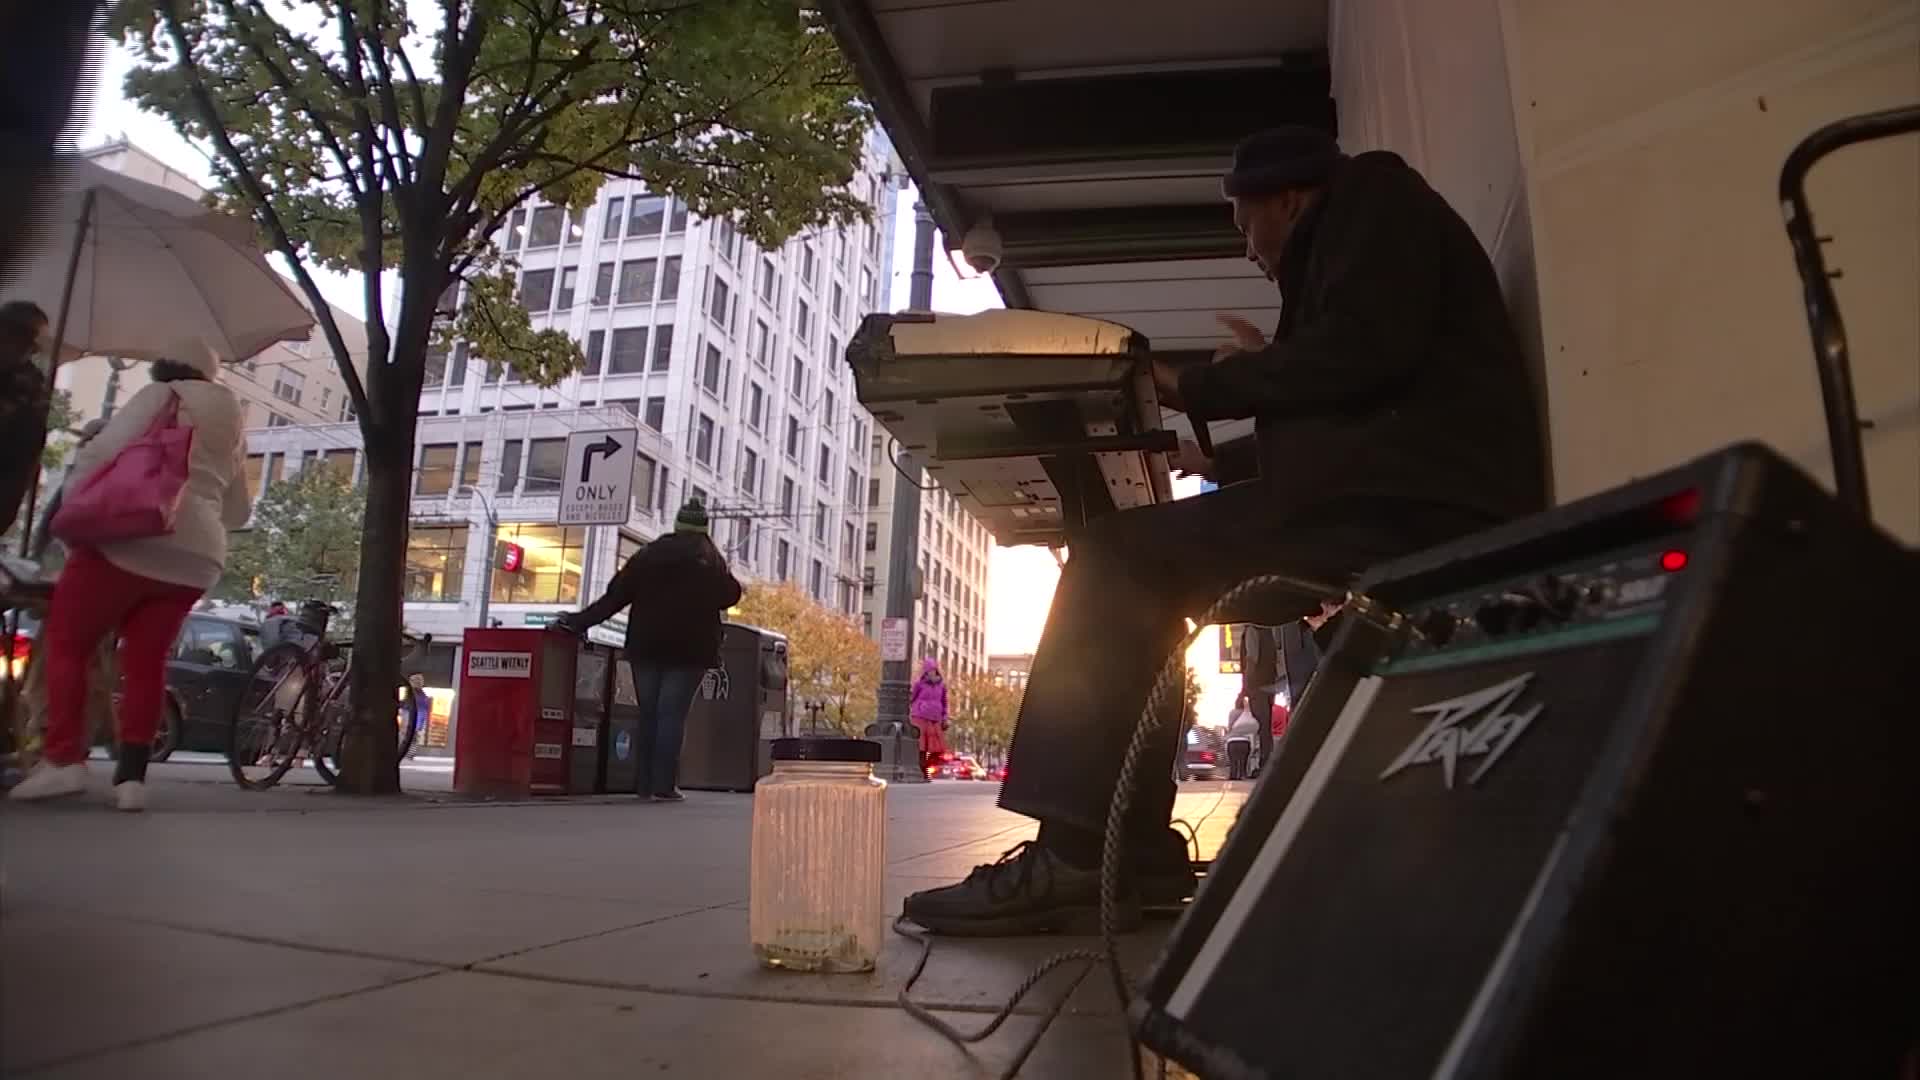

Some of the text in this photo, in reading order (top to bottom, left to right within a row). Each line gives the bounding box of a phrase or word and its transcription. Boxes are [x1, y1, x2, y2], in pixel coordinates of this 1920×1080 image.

[575, 485, 617, 501] ONLY
[471, 656, 529, 669] SEATTLE WEEKLY
